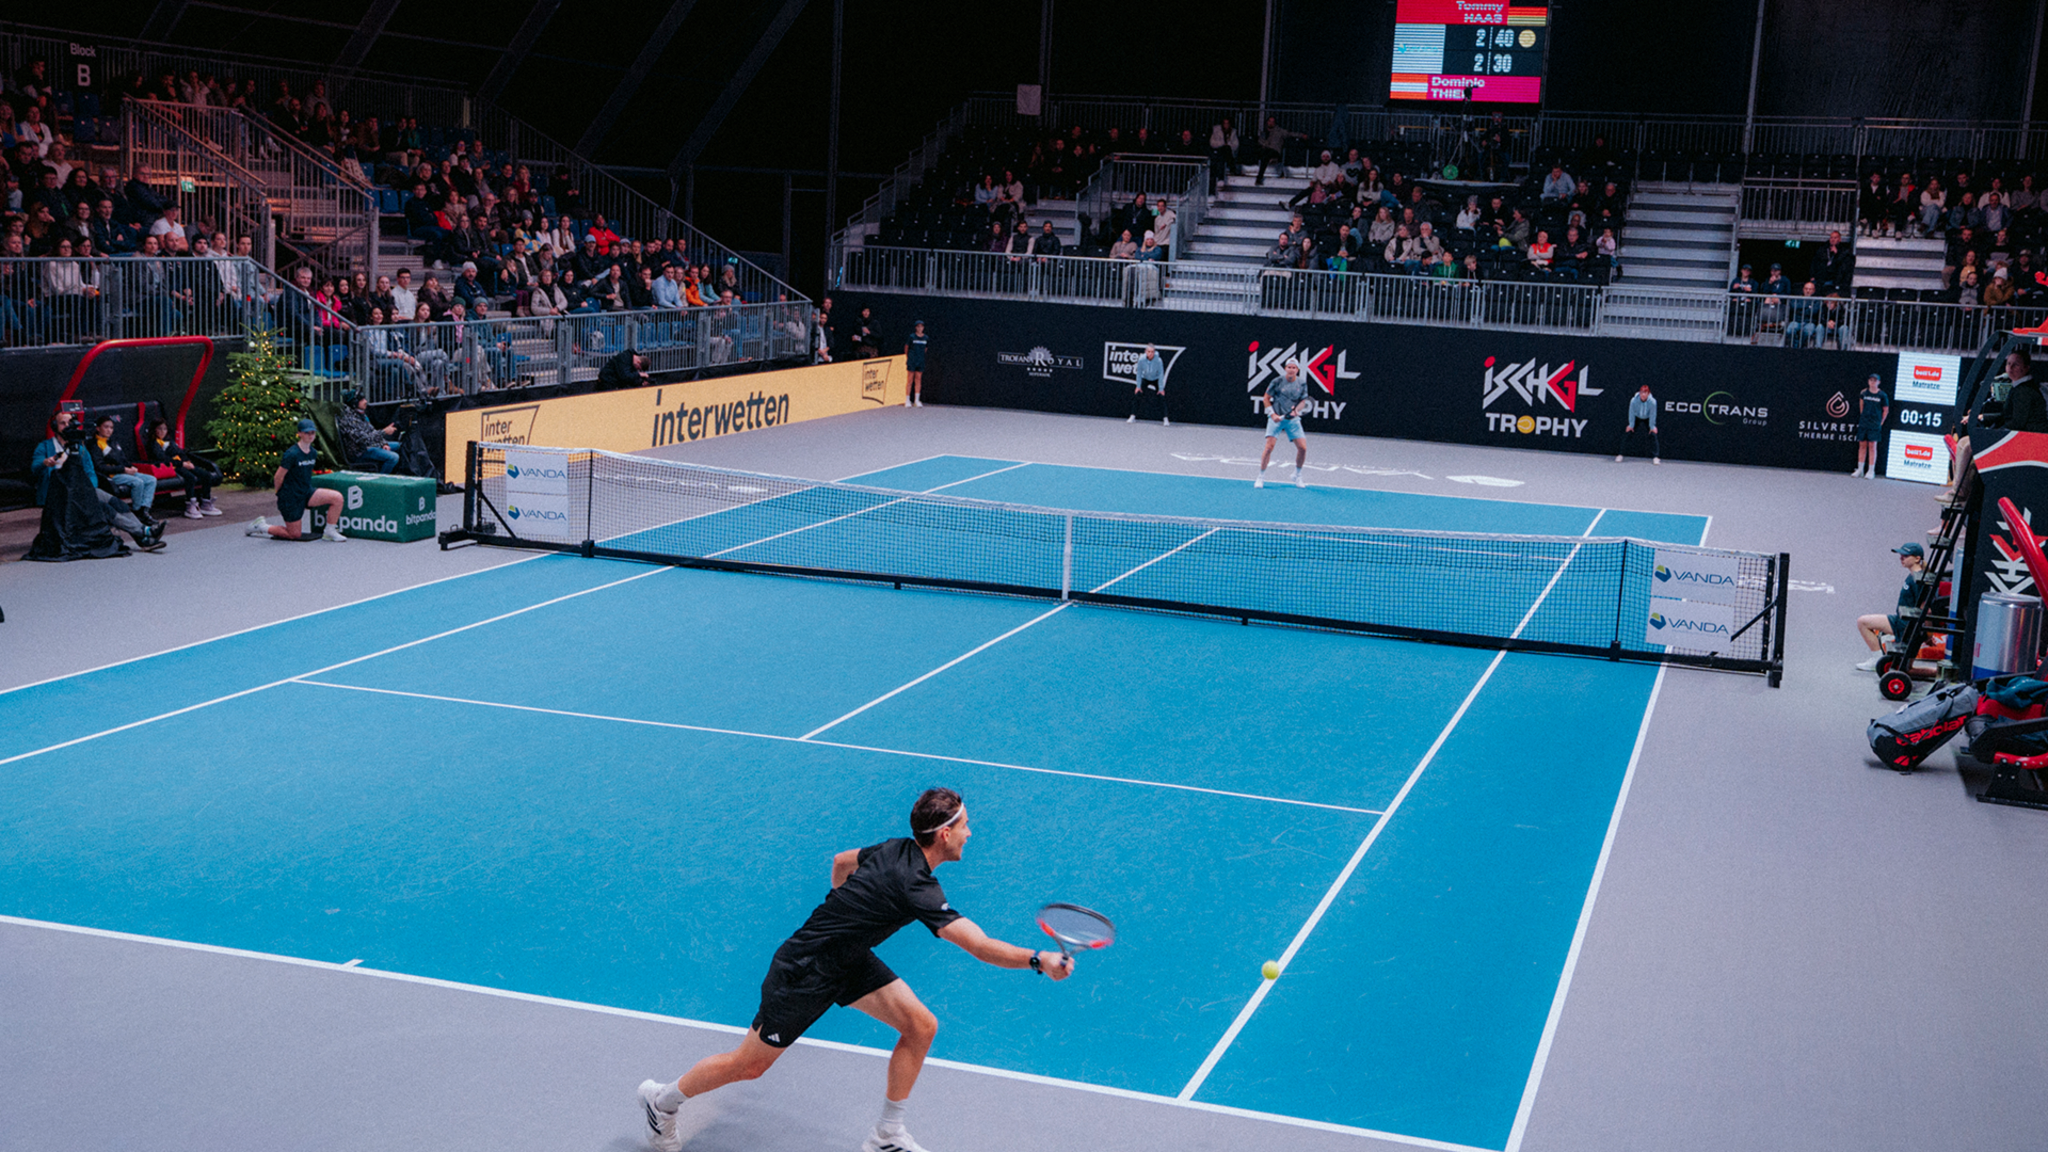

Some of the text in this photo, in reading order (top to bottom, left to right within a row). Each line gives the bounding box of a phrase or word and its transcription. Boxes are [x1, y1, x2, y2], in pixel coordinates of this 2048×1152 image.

[1456, 0, 1504, 13] Tommy
[1463, 13, 1503, 24] HAAS
[1475, 28, 1515, 48] 2 40
[70, 42, 97, 58] Block
[1473, 53, 1513, 73] 2 30
[77, 63, 91, 87] B
[1431, 76, 1486, 88] Dominic
[1430, 88, 1466, 99] THIE
[1912, 380, 1941, 390] Matratze
[652, 388, 790, 448] interwetten
[1708, 403, 1769, 418] TRANS
[484, 415, 513, 437] inter
[1743, 417, 1768, 427] Group
[1900, 409, 1942, 428] 00:15
[1798, 431, 1835, 441] THERME
[520, 466, 566, 479] VANDA
[1903, 460, 1932, 470] Matratze
[405, 509, 436, 526] bitpanda
[520, 509, 567, 522] VANDA
[1673, 570, 1735, 586] VANDA
[1668, 617, 1729, 635] VANDA
